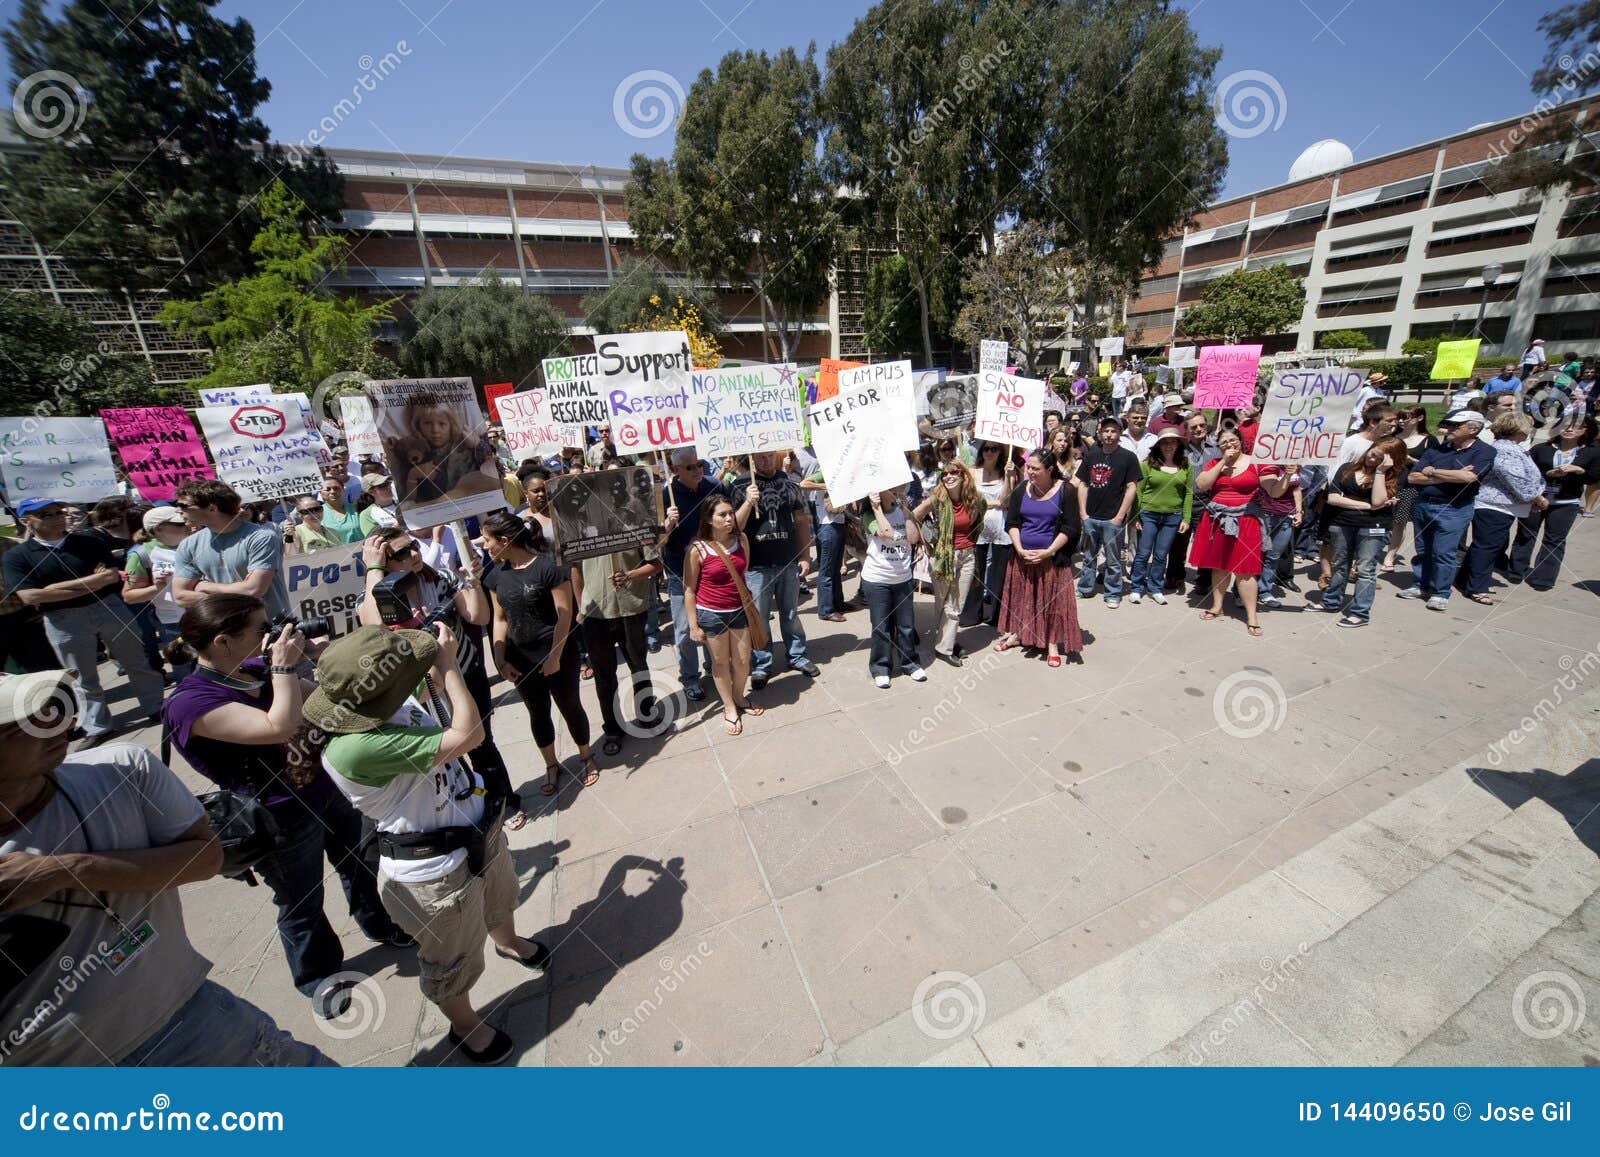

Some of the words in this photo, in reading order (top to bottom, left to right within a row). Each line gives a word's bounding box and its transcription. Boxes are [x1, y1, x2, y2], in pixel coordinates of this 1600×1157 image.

[599, 342, 690, 382] Support
[1204, 351, 1255, 364] ANIMAL
[546, 355, 599, 380] PROTECT
[841, 364, 904, 387] CAMPUS
[549, 382, 598, 400] ANIMAL
[692, 374, 716, 395] NO
[719, 371, 777, 395] ANIMAL
[983, 373, 1018, 393] SAY
[1275, 372, 1362, 399] STAND
[501, 391, 543, 420] STOP
[807, 388, 880, 426] TERROR
[995, 391, 1025, 409] NO
[1288, 396, 1324, 417] UP
[103, 407, 186, 423] RESEARCH
[551, 400, 608, 423] RESEARCH
[998, 411, 1018, 424] TO
[116, 420, 180, 433] BENEFITS
[237, 415, 280, 427] STOP
[513, 417, 537, 428] THE
[698, 416, 721, 435] NO
[843, 420, 855, 434] IS
[1276, 416, 1325, 435] FOR
[114, 430, 189, 446] HUMAN
[507, 424, 559, 450] BOMBING
[219, 445, 242, 457] ALF
[1254, 432, 1343, 461] SCIENCE
[126, 456, 205, 472] ANIMAL
[220, 458, 255, 471] PETA
[144, 471, 207, 487] LIVES
[231, 478, 263, 490] FROM
